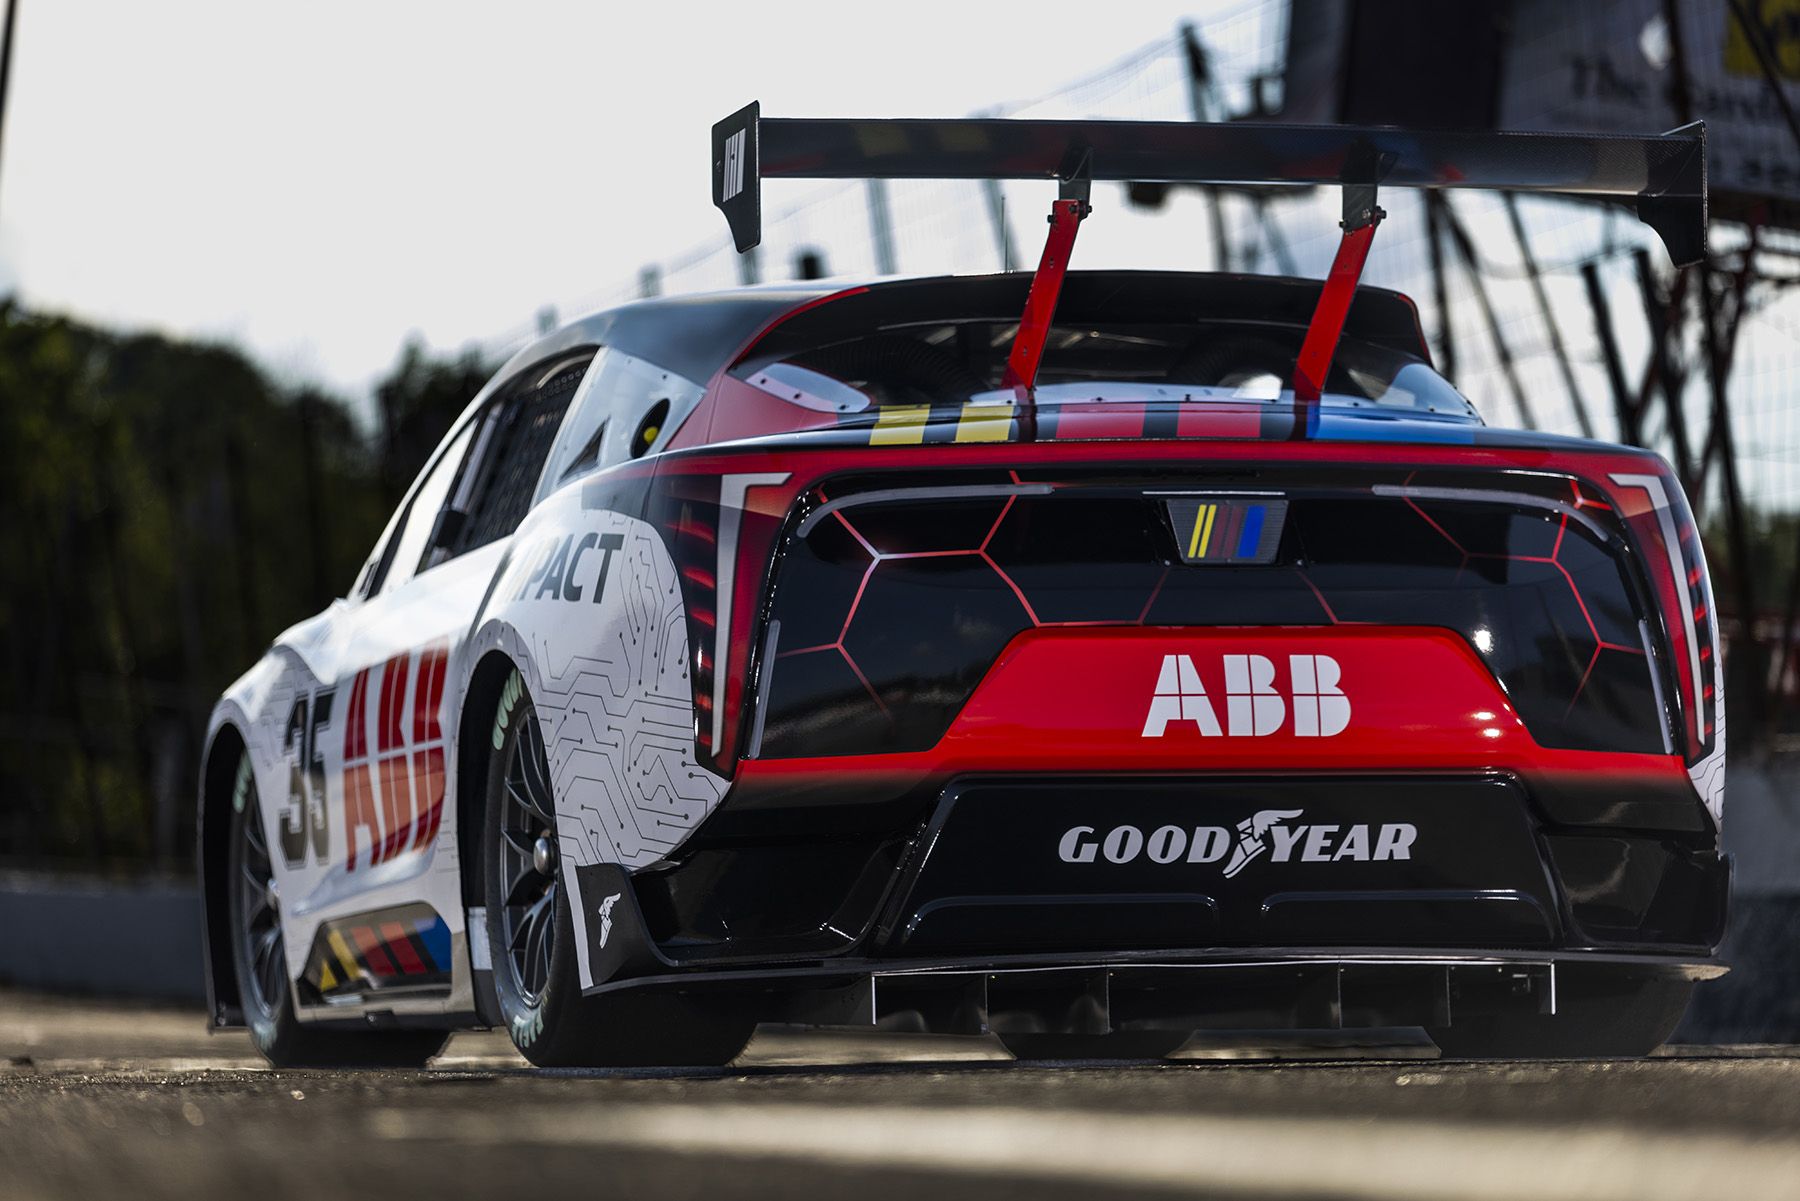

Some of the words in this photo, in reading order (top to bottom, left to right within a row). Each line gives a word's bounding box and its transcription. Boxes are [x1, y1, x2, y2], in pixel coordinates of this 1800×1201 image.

[510, 532, 625, 604] PACT
[1141, 654, 1352, 737] ABB
[277, 686, 338, 870] 35
[343, 634, 449, 873] ABB
[1057, 822, 1418, 866] GOODYEAR
